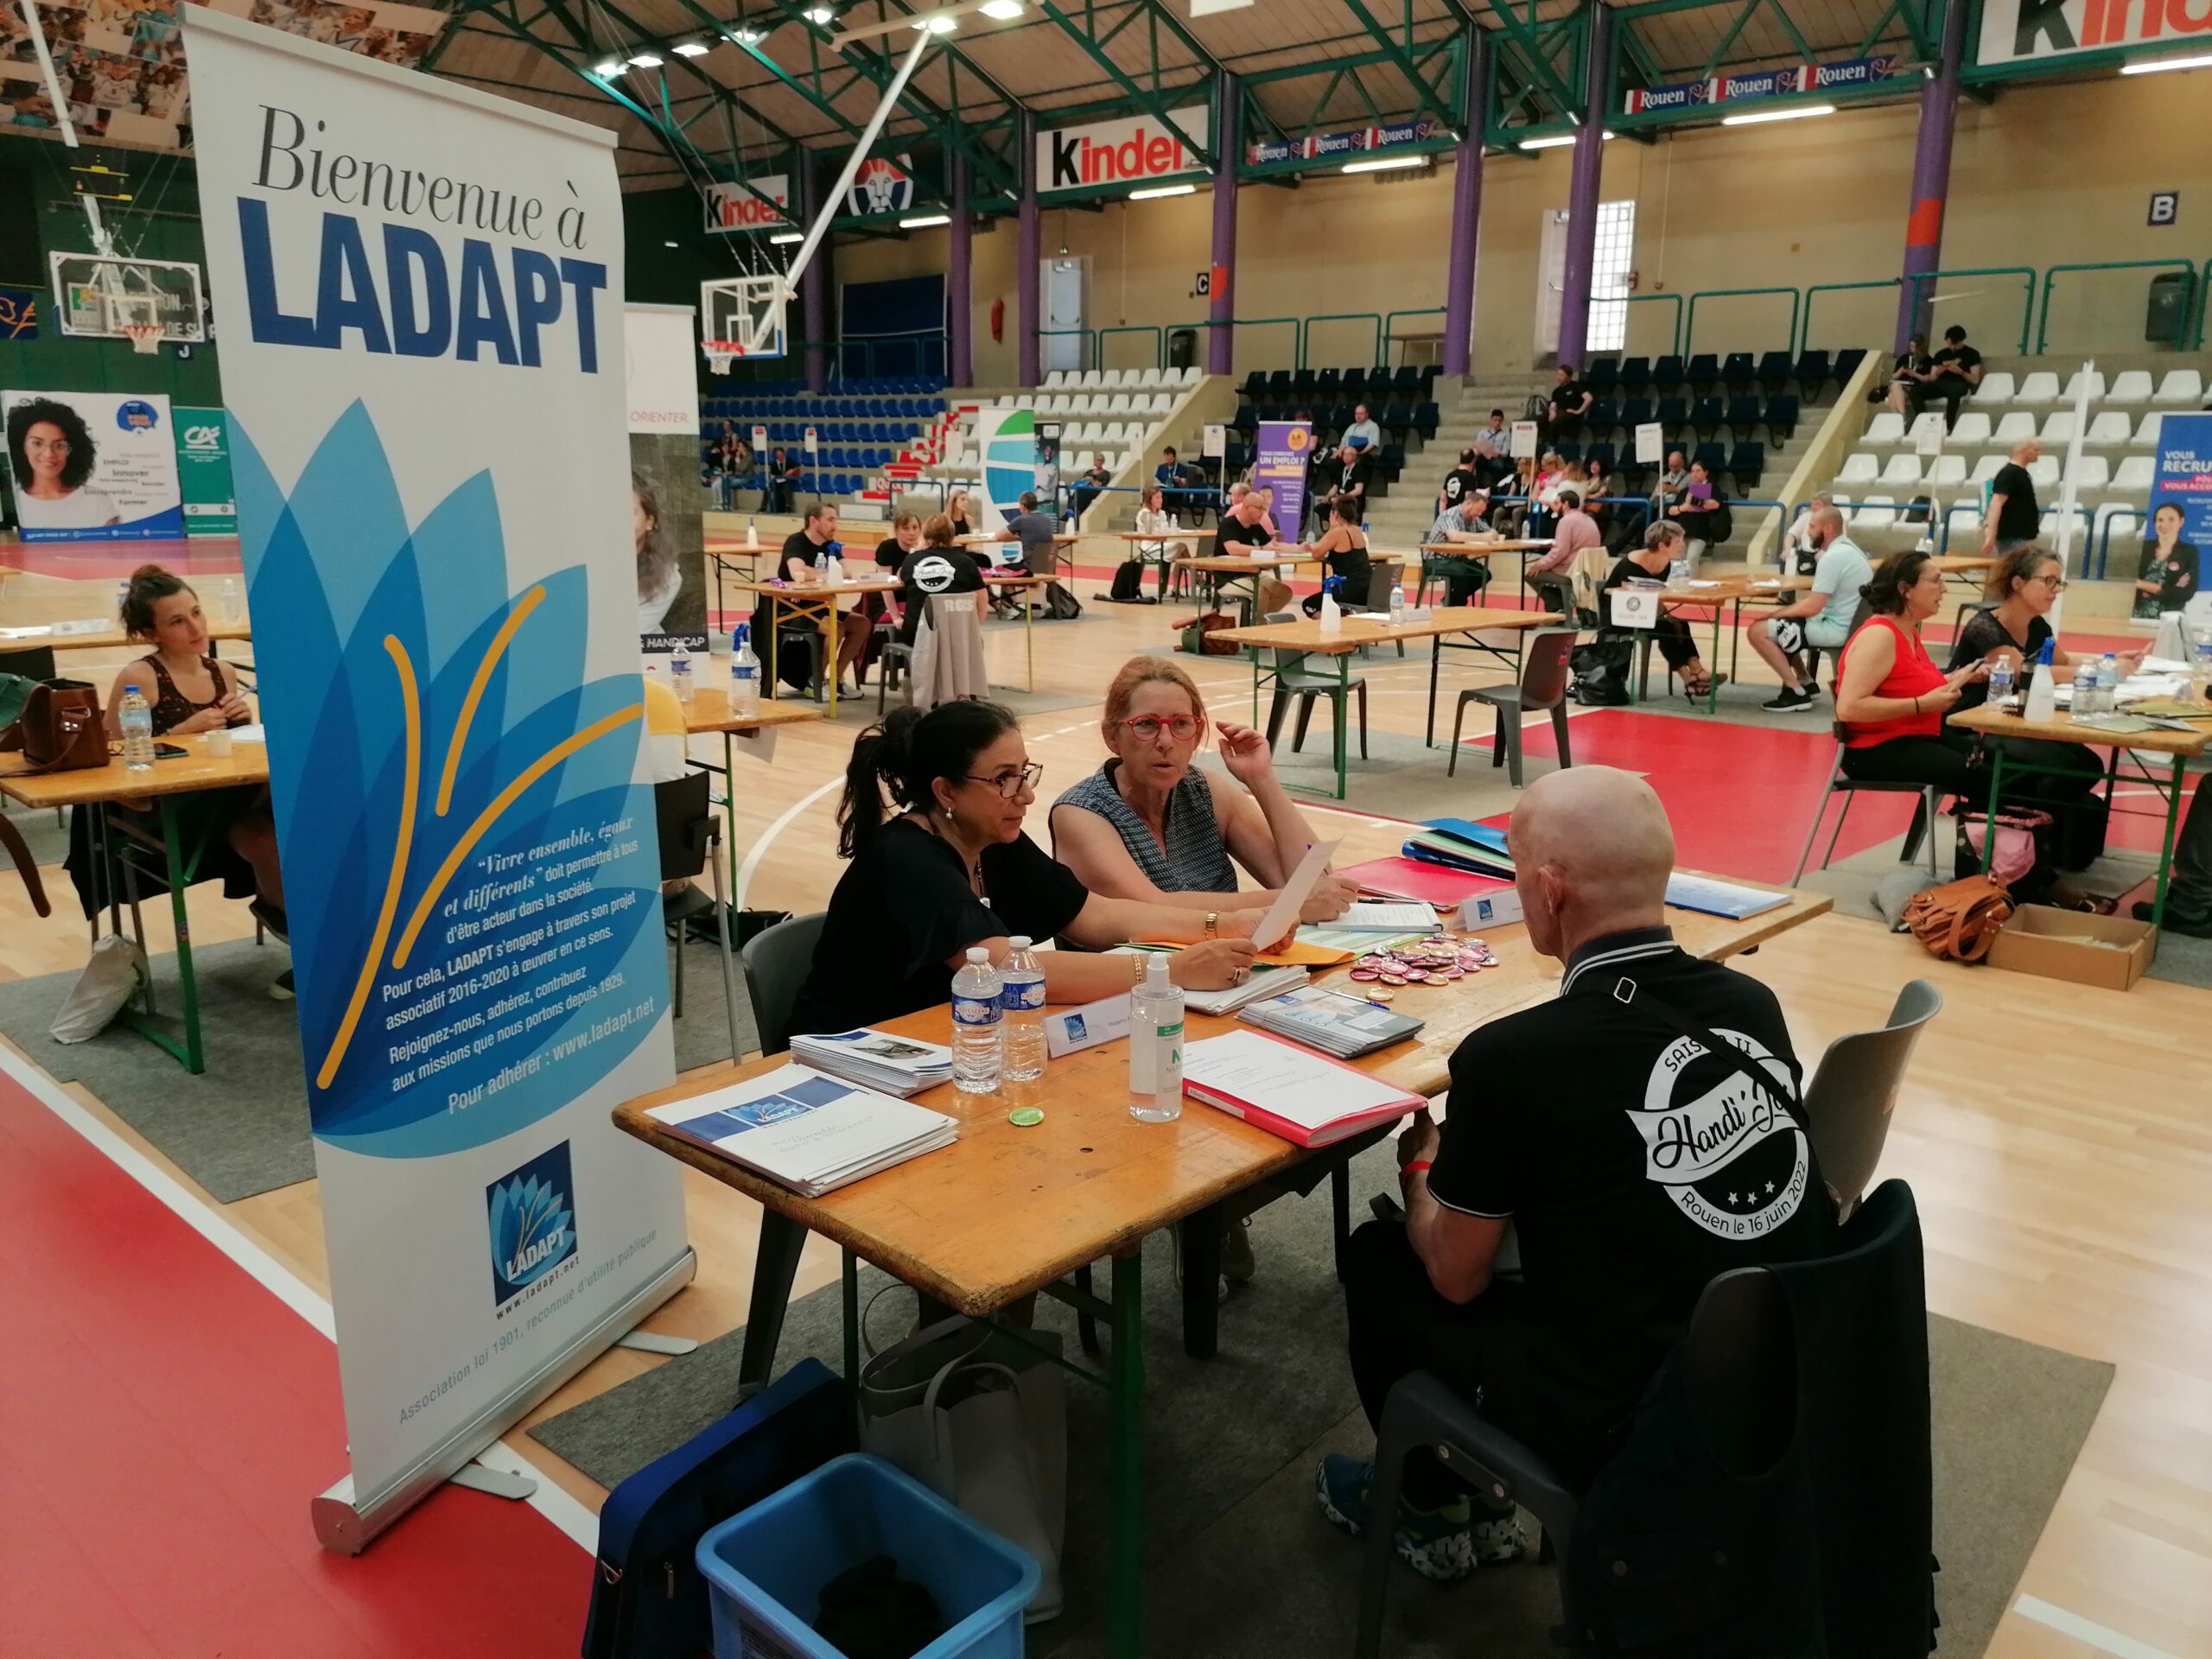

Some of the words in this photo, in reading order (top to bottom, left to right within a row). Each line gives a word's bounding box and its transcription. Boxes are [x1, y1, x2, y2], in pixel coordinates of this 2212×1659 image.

[1640, 90, 1685, 108] Rouen
[1726, 76, 1772, 96] Rouen
[1815, 64, 1866, 85] Rouen
[1255, 144, 1288, 162] Rouen
[1317, 137, 1349, 154] Rouen
[1377, 128, 1414, 145] Rouen
[252, 104, 543, 241] Bienvenue
[557, 179, 588, 251] à
[2151, 196, 2175, 221] B
[236, 196, 607, 374] LADAPT
[1198, 275, 1208, 293] C
[178, 345, 190, 359] J
[2164, 450, 2196, 460] VOUS
[647, 635, 706, 649] HANDICAP
[528, 827, 594, 861] ensemble,
[598, 817, 633, 842] égaux
[444, 898, 459, 918] et
[545, 867, 564, 882] doit
[566, 852, 612, 877] permettre
[613, 844, 620, 858] à
[620, 839, 639, 856] tous
[447, 922, 480, 944] d'être
[483, 907, 517, 931] acteur
[519, 898, 544, 918] dans
[546, 893, 556, 907] la
[556, 877, 594, 904] société.
[383, 979, 413, 1002] Pour
[416, 967, 446, 989] cela,
[447, 944, 493, 976] LADAPT
[497, 930, 545, 958] s'engage
[546, 921, 554, 937] à
[554, 910, 589, 933] travers
[591, 904, 609, 919] son
[610, 890, 637, 916] projet
[385, 990, 447, 1030] associatif
[448, 964, 510, 1004] 2016-2020
[512, 961, 519, 977] à
[521, 948, 558, 973] œuvrer
[560, 942, 572, 957] en
[575, 936, 587, 950] ce
[588, 925, 614, 945] sens.
[389, 1011, 486, 1065] Rejoignez-nous,
[487, 991, 534, 1020] adhérez,
[535, 966, 588, 998] contribuez
[391, 1069, 416, 1092] aux
[417, 1044, 471, 1080] missions
[474, 1033, 495, 1055] que
[497, 1020, 524, 1042] nous
[525, 1001, 564, 1033] portons
[566, 984, 598, 1011] depuis
[600, 972, 626, 995] 1929.
[448, 1083, 484, 1115] Pour
[487, 1054, 542, 1095] adhérer
[553, 995, 655, 1061] www.ladapt.net
[1681, 1191, 1730, 1233] Rouen
[1733, 1218, 1745, 1236] le
[1748, 1217, 1764, 1233] 16
[1764, 1199, 1793, 1230] juin
[1791, 1160, 1807, 1204] 2022
[506, 1224, 567, 1282] LADAPT
[496, 1255, 580, 1319] www.ladapt.net
[398, 1363, 471, 1425] Association
[474, 1351, 490, 1369] loi
[493, 1326, 524, 1356] 1901,
[526, 1288, 575, 1331] reconnue
[577, 1257, 616, 1294] d'utilité
[618, 1230, 657, 1266] publique
